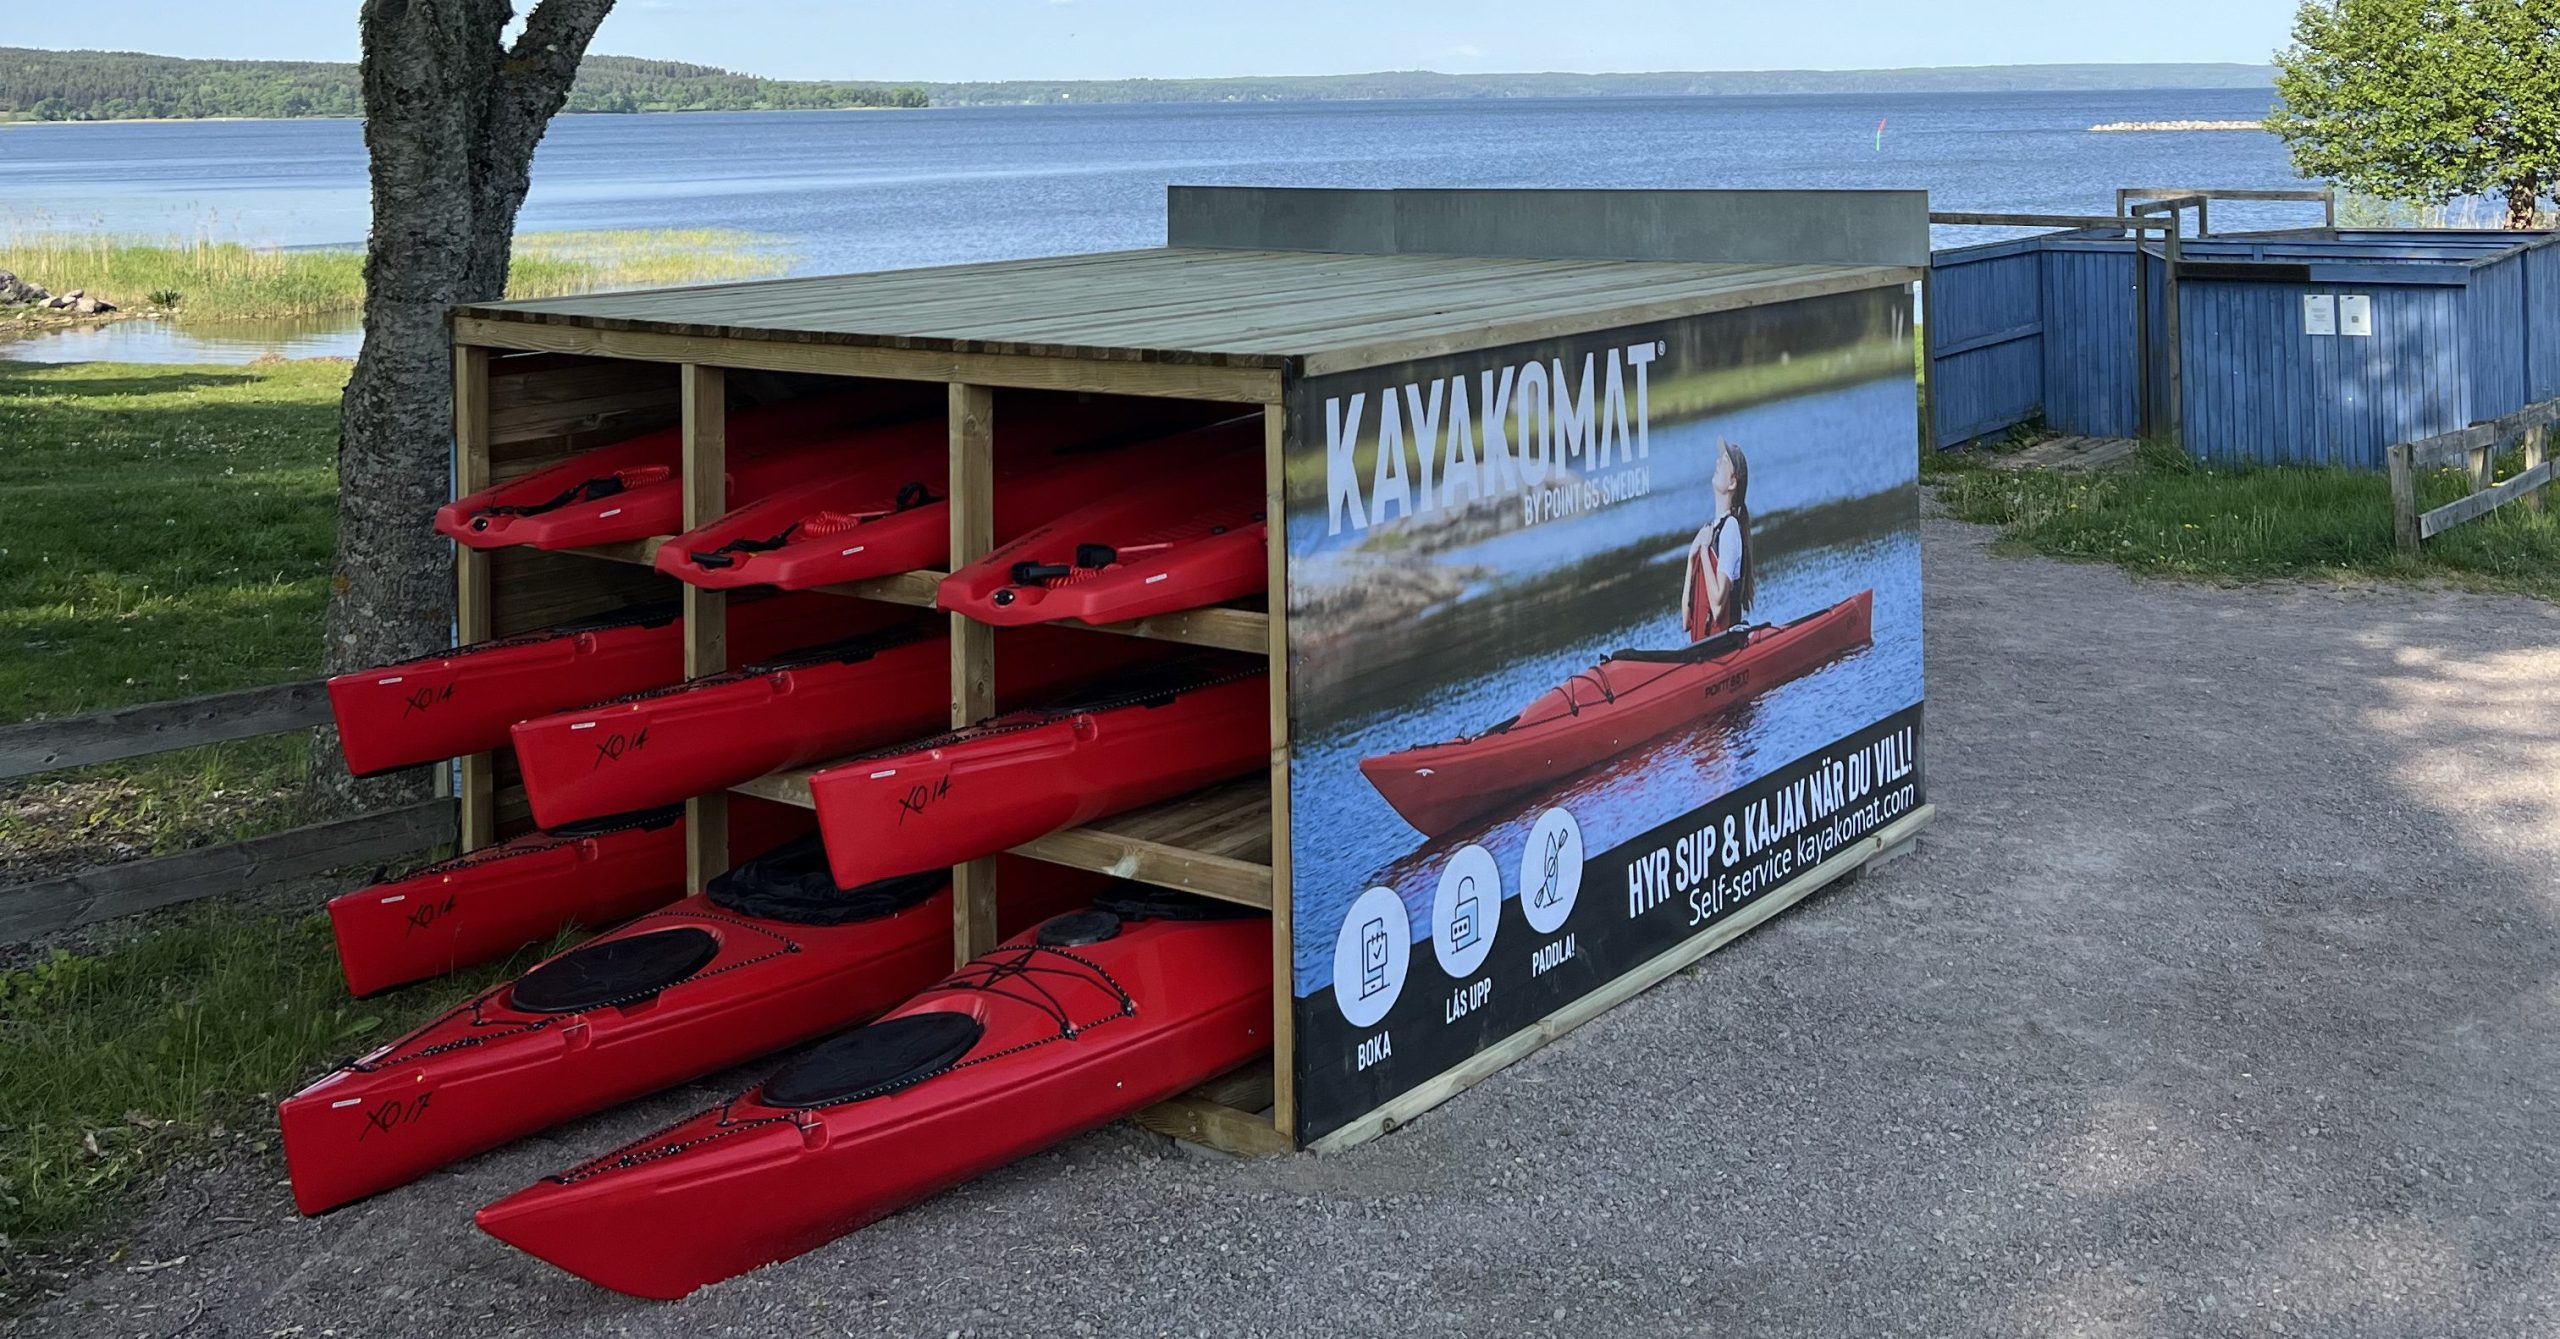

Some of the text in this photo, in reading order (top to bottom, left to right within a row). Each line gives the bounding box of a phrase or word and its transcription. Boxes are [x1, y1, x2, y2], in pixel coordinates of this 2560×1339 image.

[1525, 466, 1650, 526] BY POINT 65 SWEDEN
[1628, 726, 1913, 919] HYR SUP & KAJAK NÄR DU VILL!
[1689, 783, 1914, 926] Self-service kayakomat.com
[1532, 933, 1575, 978] PADDLA!
[1446, 977, 1492, 1025] LÅS UPP
[1358, 1030, 1392, 1072] BOKA
